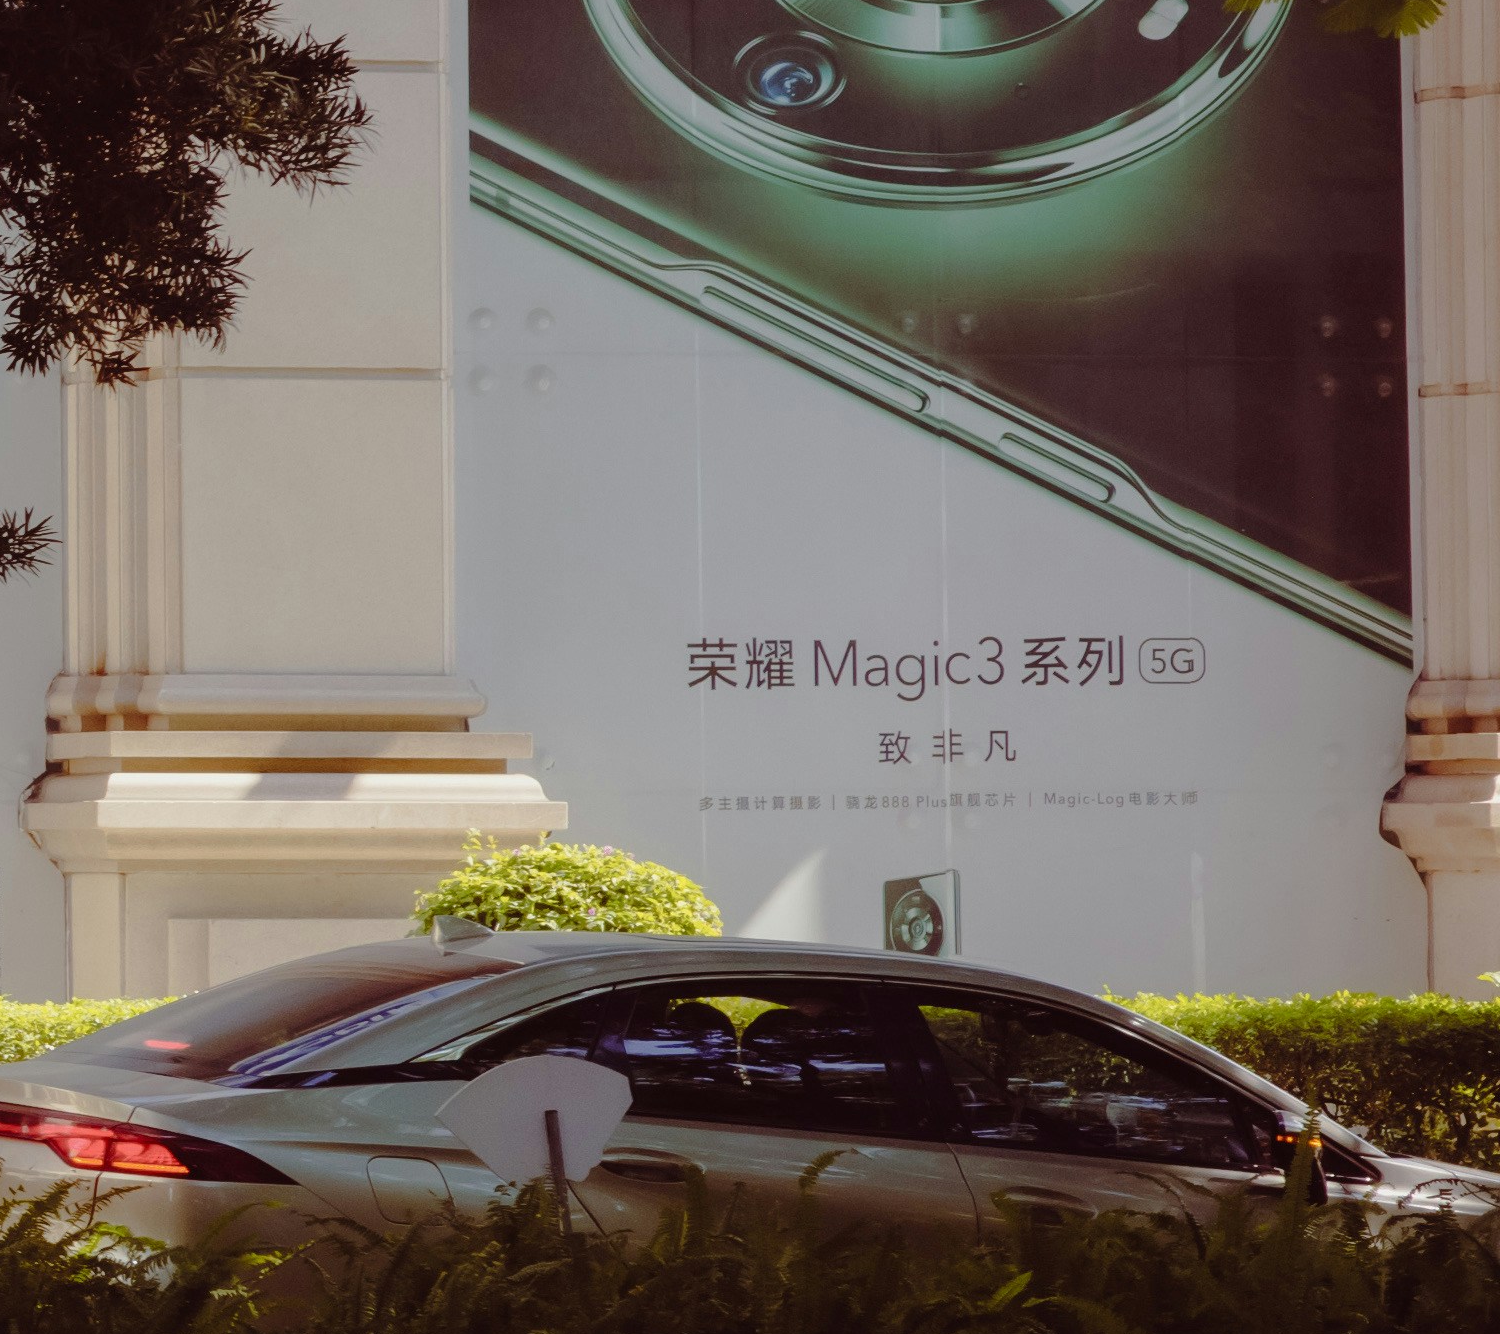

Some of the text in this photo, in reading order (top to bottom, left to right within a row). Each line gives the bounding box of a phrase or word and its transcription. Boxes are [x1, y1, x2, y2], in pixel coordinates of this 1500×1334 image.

[687, 635, 1195, 701] 荣耀 Magic3 系列 5G
[878, 729, 1017, 765] 致非凡
